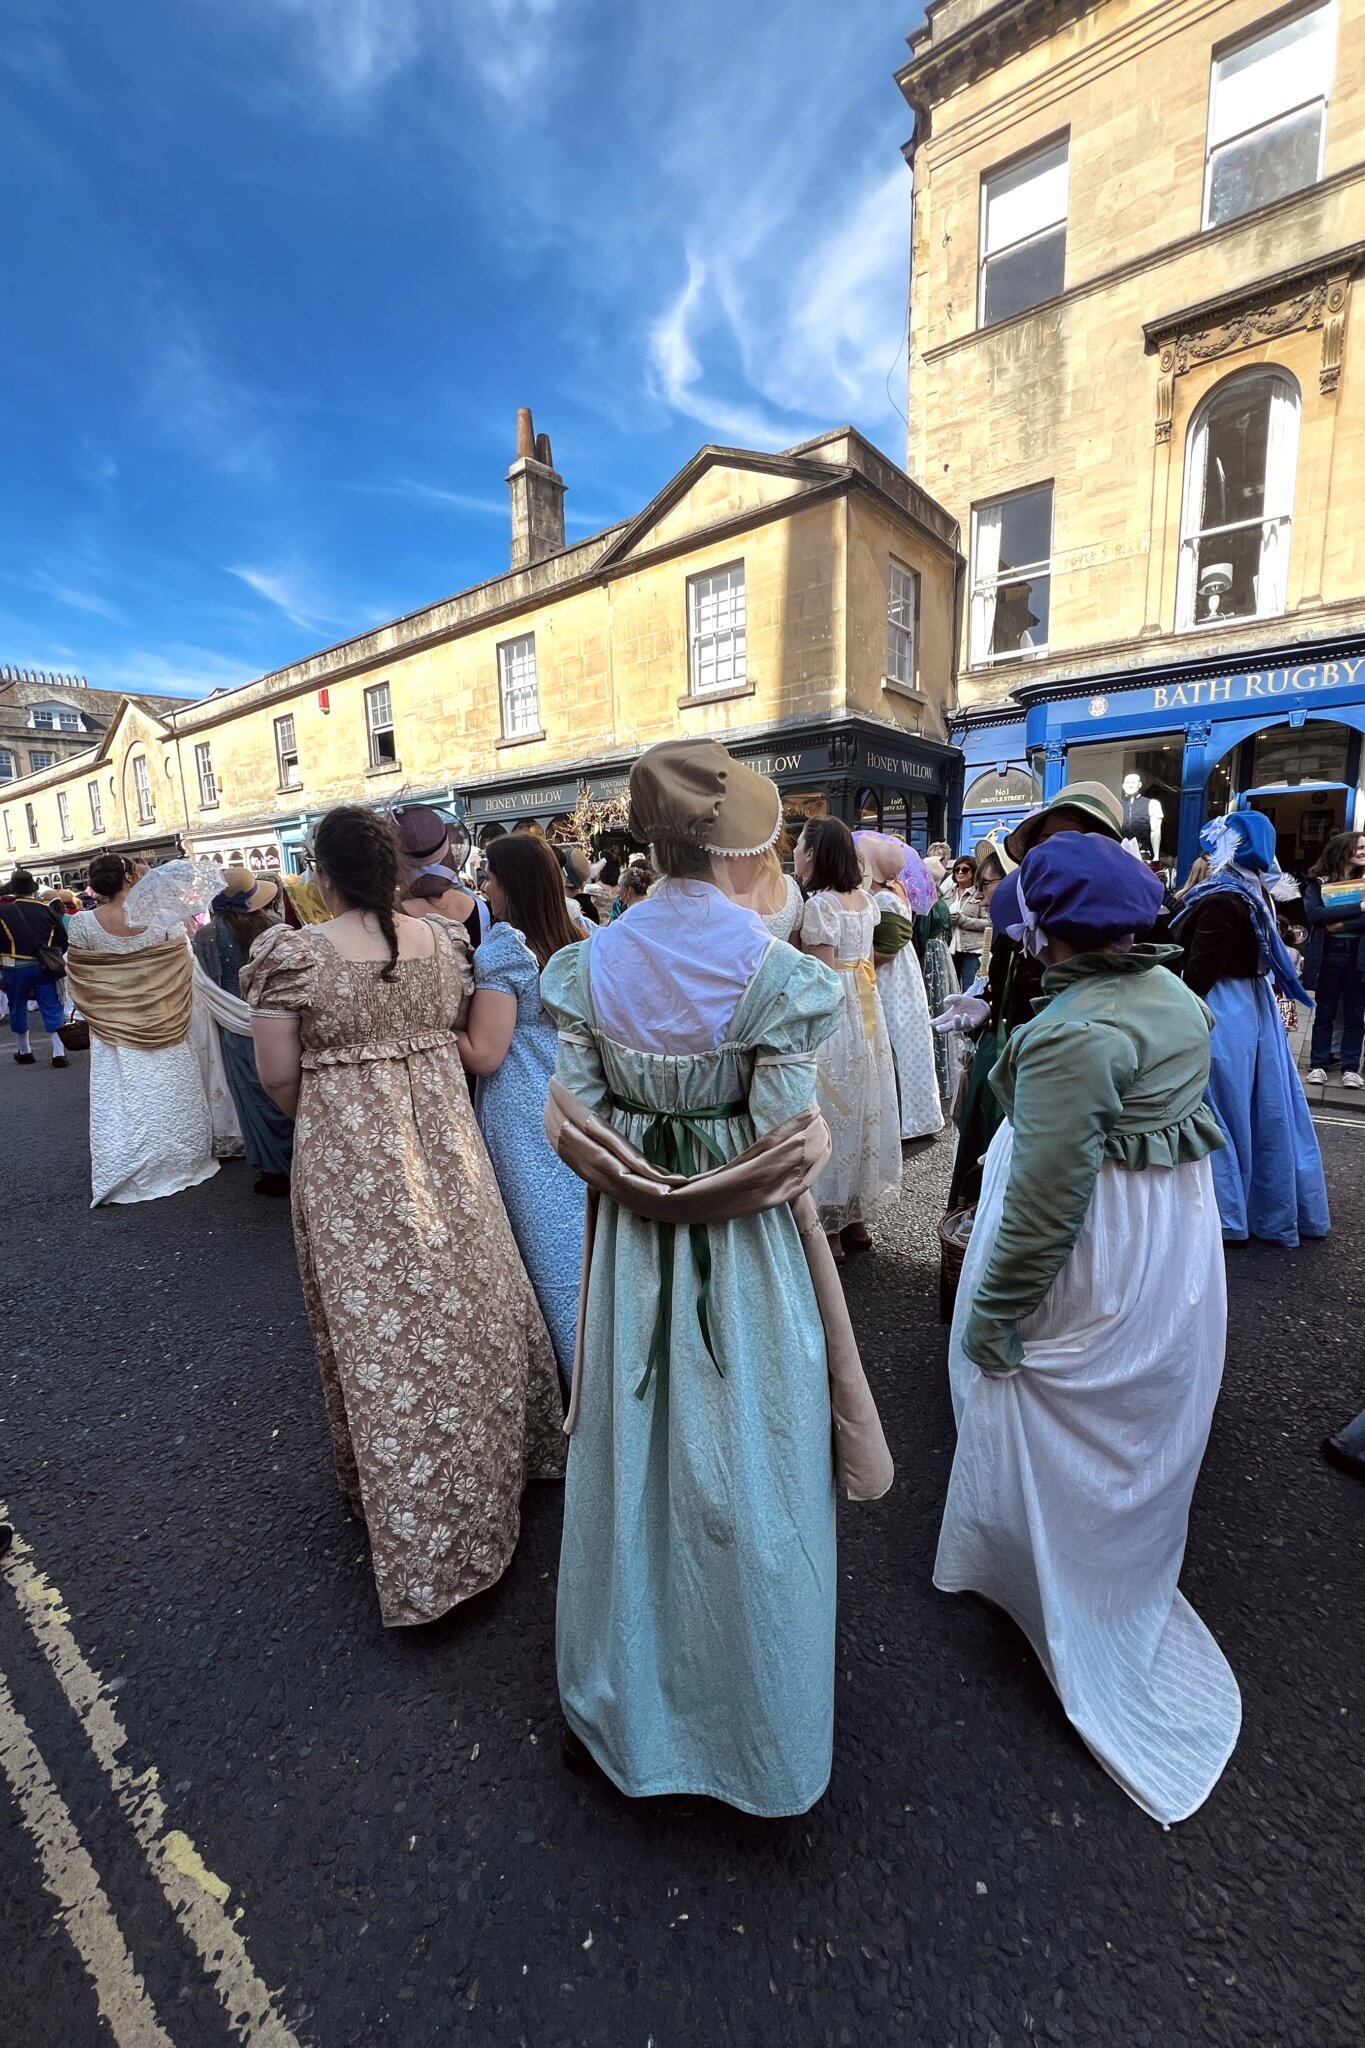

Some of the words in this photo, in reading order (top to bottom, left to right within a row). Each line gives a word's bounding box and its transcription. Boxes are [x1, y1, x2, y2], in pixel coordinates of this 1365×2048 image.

[1153, 678, 1234, 709] BATH
[1244, 659, 1365, 698] RUGBY
[866, 751, 899, 773] HONEY
[901, 759, 934, 781] WILLOW
[600, 778, 631, 789] HANDMAD
[485, 795, 518, 812] HONEY
[520, 790, 563, 806] WILLOW
[980, 796, 1003, 804] ARGYLE
[1003, 794, 1026, 802] STREET
